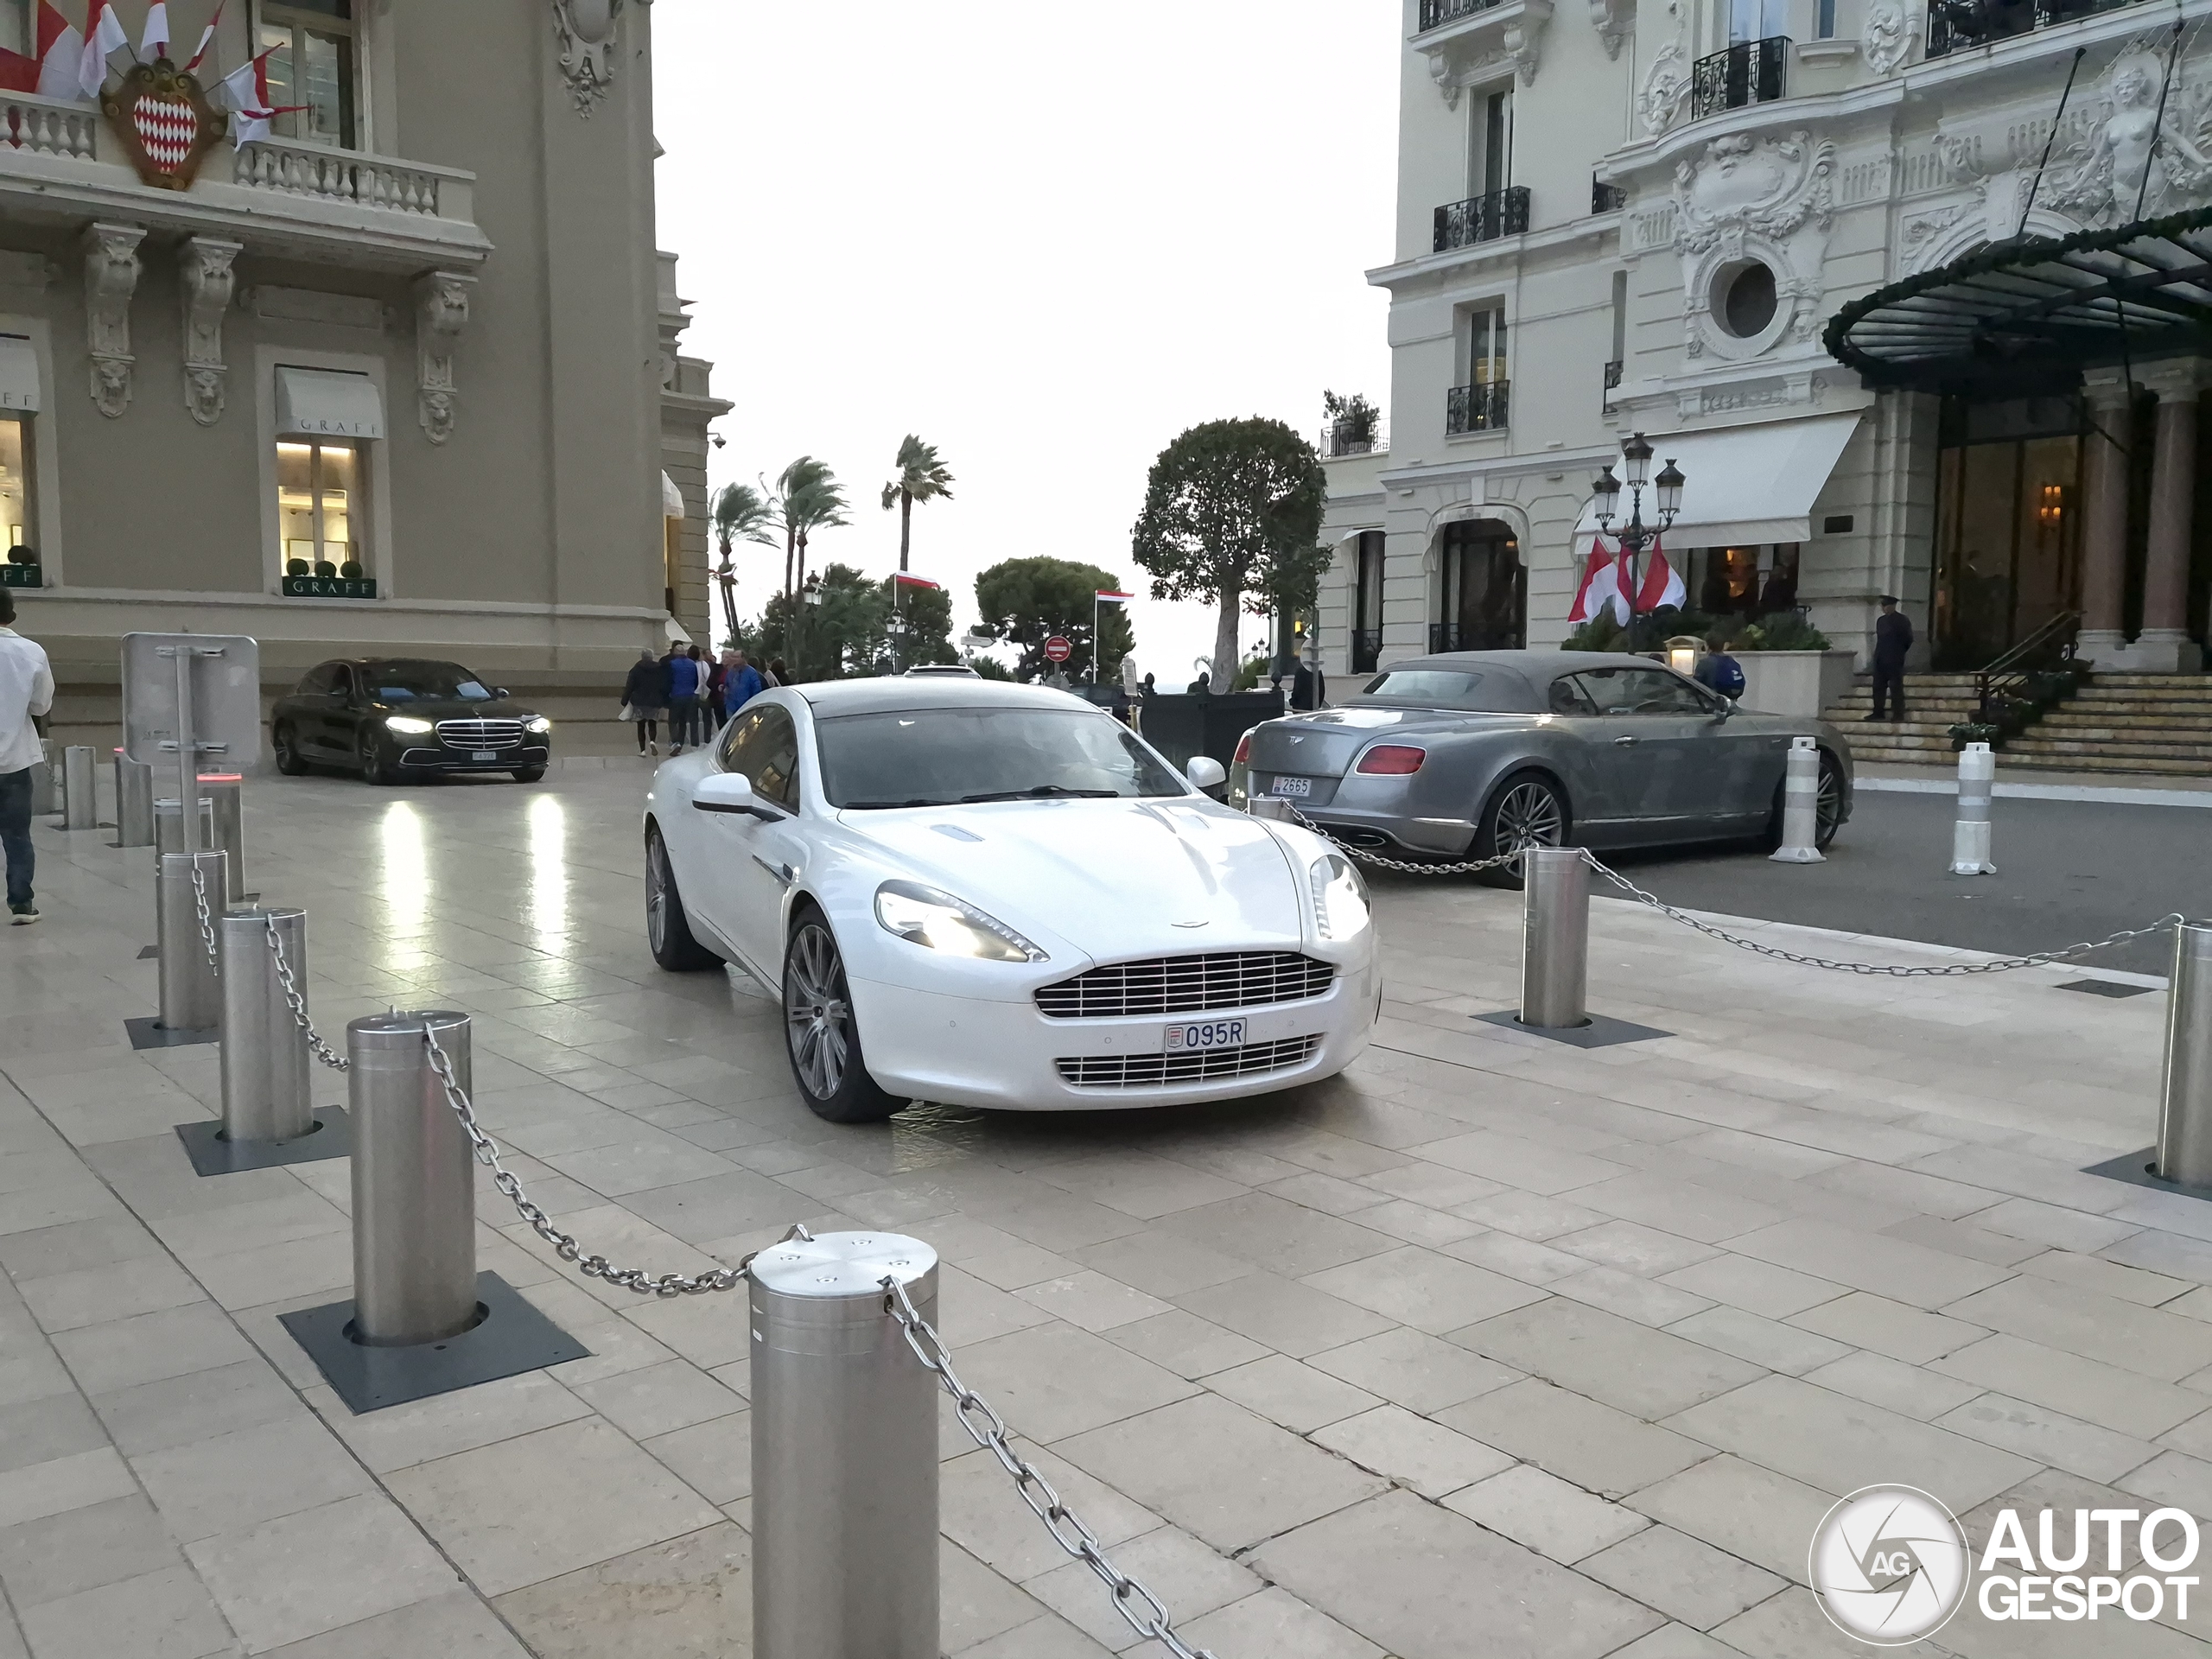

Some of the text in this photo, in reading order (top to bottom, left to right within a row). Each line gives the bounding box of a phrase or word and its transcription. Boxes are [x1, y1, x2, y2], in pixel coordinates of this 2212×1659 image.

[300, 418, 377, 435] GRAFF
[293, 581, 370, 594] GRAFF
[1282, 779, 1308, 792] 2665
[1186, 1022, 1243, 1047] 095R
